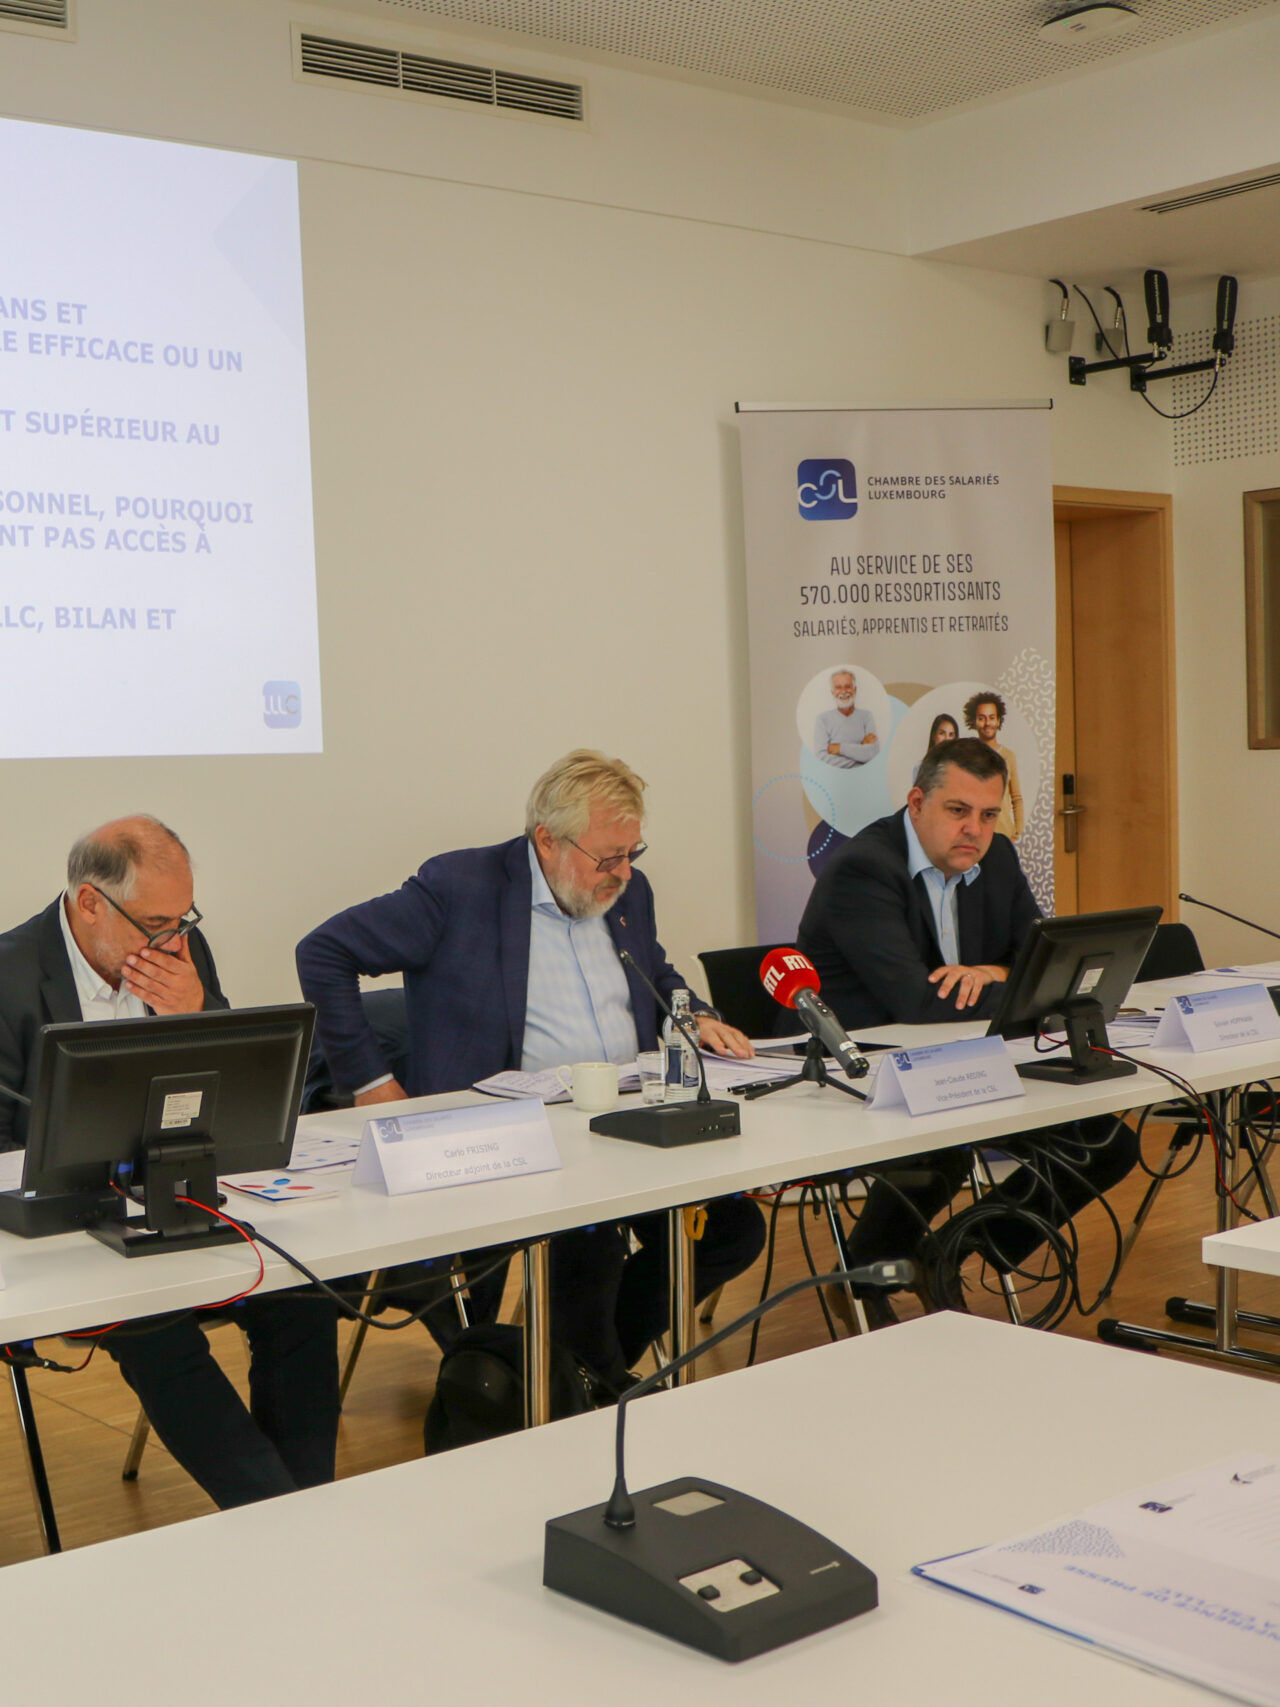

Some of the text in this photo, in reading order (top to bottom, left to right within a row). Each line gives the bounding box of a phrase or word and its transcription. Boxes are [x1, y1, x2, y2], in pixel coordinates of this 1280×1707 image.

[57, 301, 87, 325] ET
[28, 332, 154, 364] EFFICACE
[163, 345, 199, 368] OU
[208, 349, 243, 372] UN
[25, 408, 178, 444] SUPÉRIEUR
[186, 423, 220, 445] AU
[868, 473, 1000, 487] CHAMBRE DES SALARIÉS
[868, 489, 946, 500] LUXEMBOURG
[115, 496, 254, 527] POURQUOI
[44, 527, 95, 550] PAS
[104, 526, 187, 554] ACCÈS
[195, 527, 212, 554] À
[830, 553, 973, 576] AU SERVICE DE SES
[800, 581, 1001, 605] 570.000 RESSORTISSANTS
[55, 607, 137, 630] BILAN
[146, 608, 176, 630] ET
[793, 613, 1008, 637] SALARIÉS, APPRENTIS ET RETRAITÉS
[782, 955, 815, 971] RTL
[763, 966, 785, 996] RTL
[466, 1142, 500, 1156] FRISING
[426, 1167, 462, 1181] Directeur
[492, 1159, 503, 1170] de
